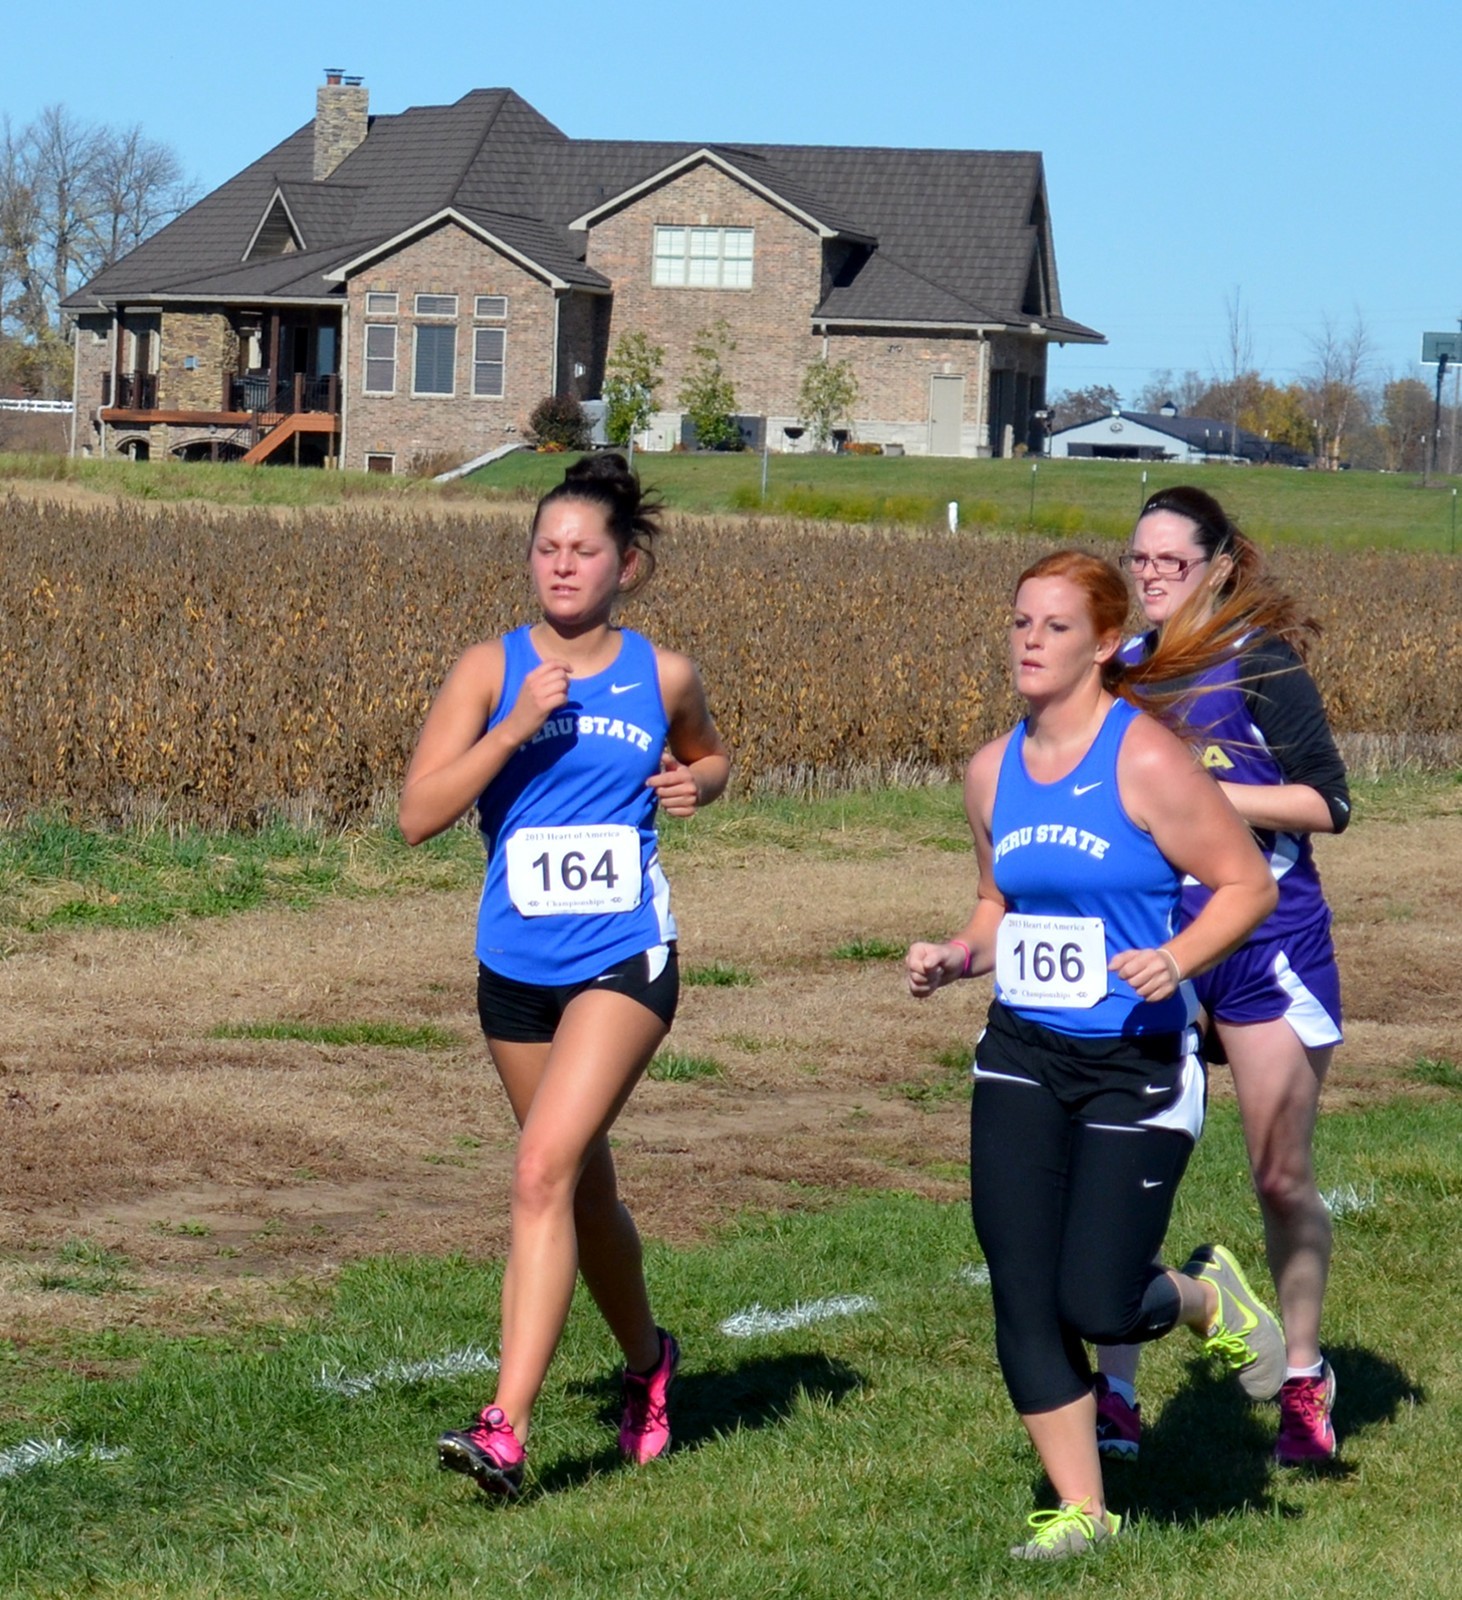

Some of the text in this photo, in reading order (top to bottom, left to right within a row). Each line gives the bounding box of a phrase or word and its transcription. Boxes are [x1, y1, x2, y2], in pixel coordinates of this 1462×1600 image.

[520, 716, 653, 752] ERU STATE
[525, 830, 620, 841] 2013 Heart of America
[995, 824, 1111, 864] PERU STATE
[532, 849, 619, 892] 164
[546, 898, 606, 909] Championships
[1023, 920, 1042, 929] Heart
[1043, 921, 1051, 930] of
[1052, 922, 1085, 931] America
[1013, 940, 1085, 983] 166
[1021, 989, 1071, 999] Championships
